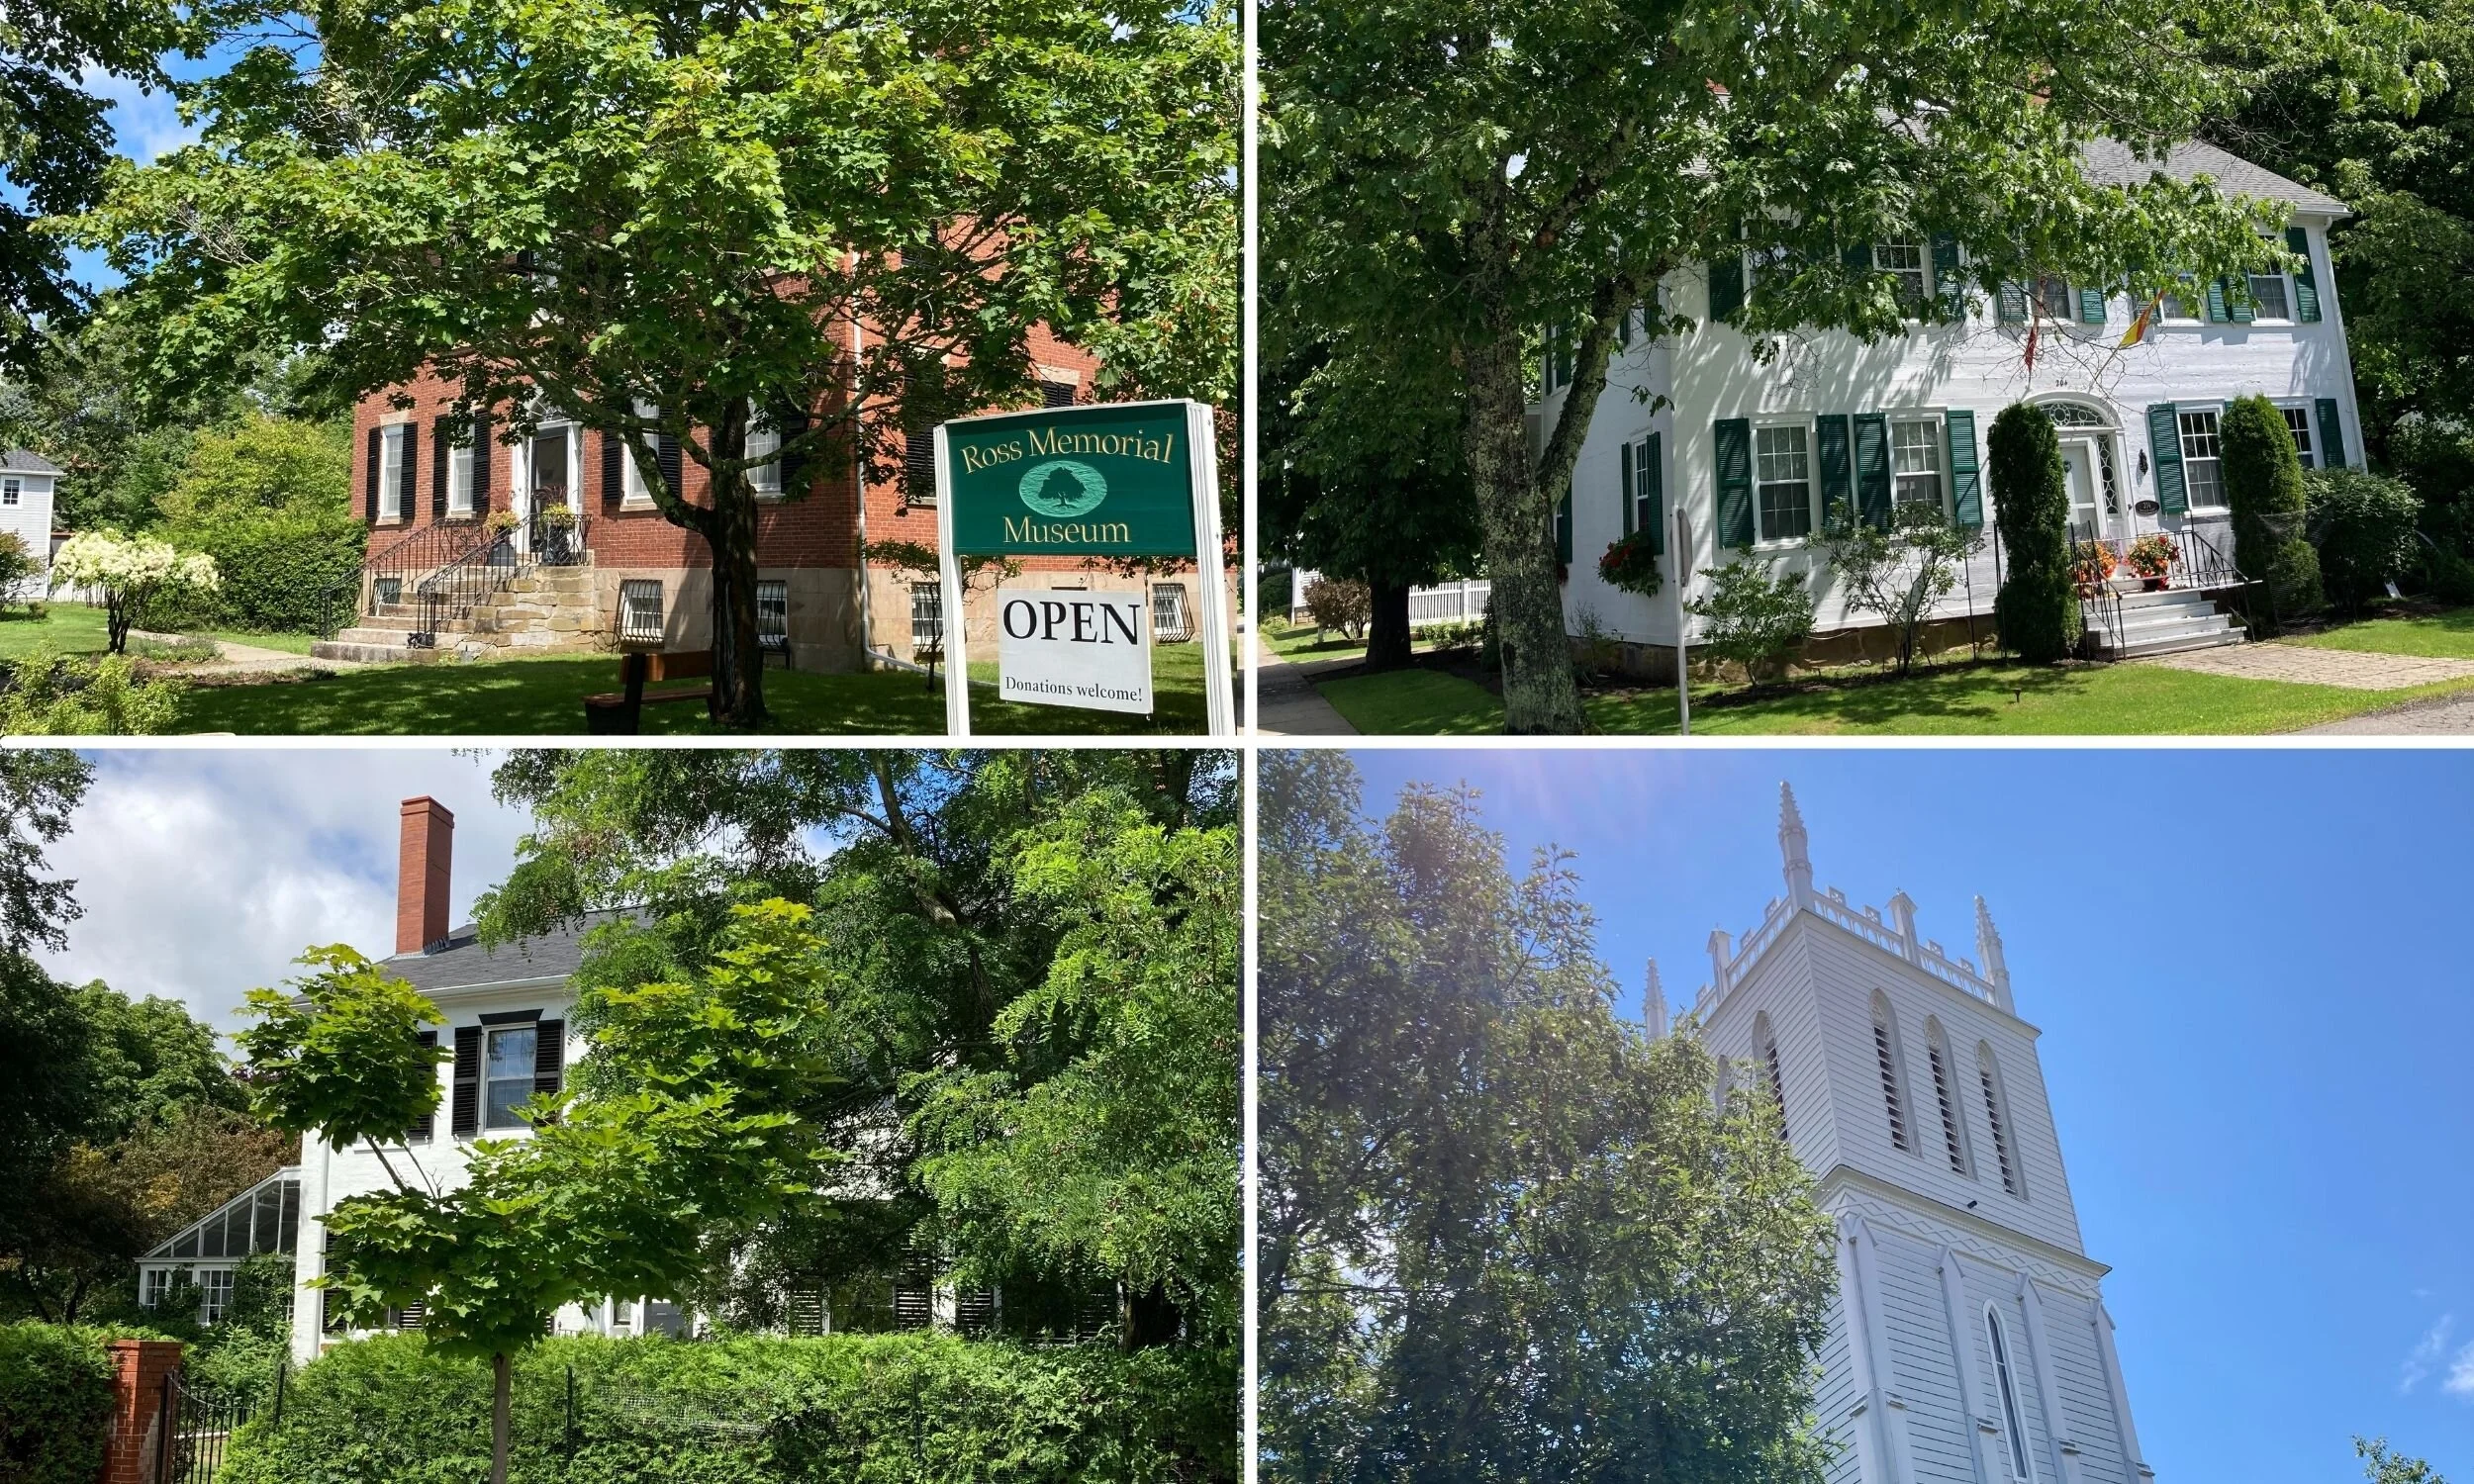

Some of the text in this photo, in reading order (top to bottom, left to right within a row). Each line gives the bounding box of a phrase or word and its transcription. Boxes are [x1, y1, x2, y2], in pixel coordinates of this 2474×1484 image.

[960, 426, 1174, 475] Ross Memorial
[1002, 515, 1132, 544] Museum
[1002, 600, 1141, 645] OPEN
[1005, 676, 1142, 701] Donations welcome!
